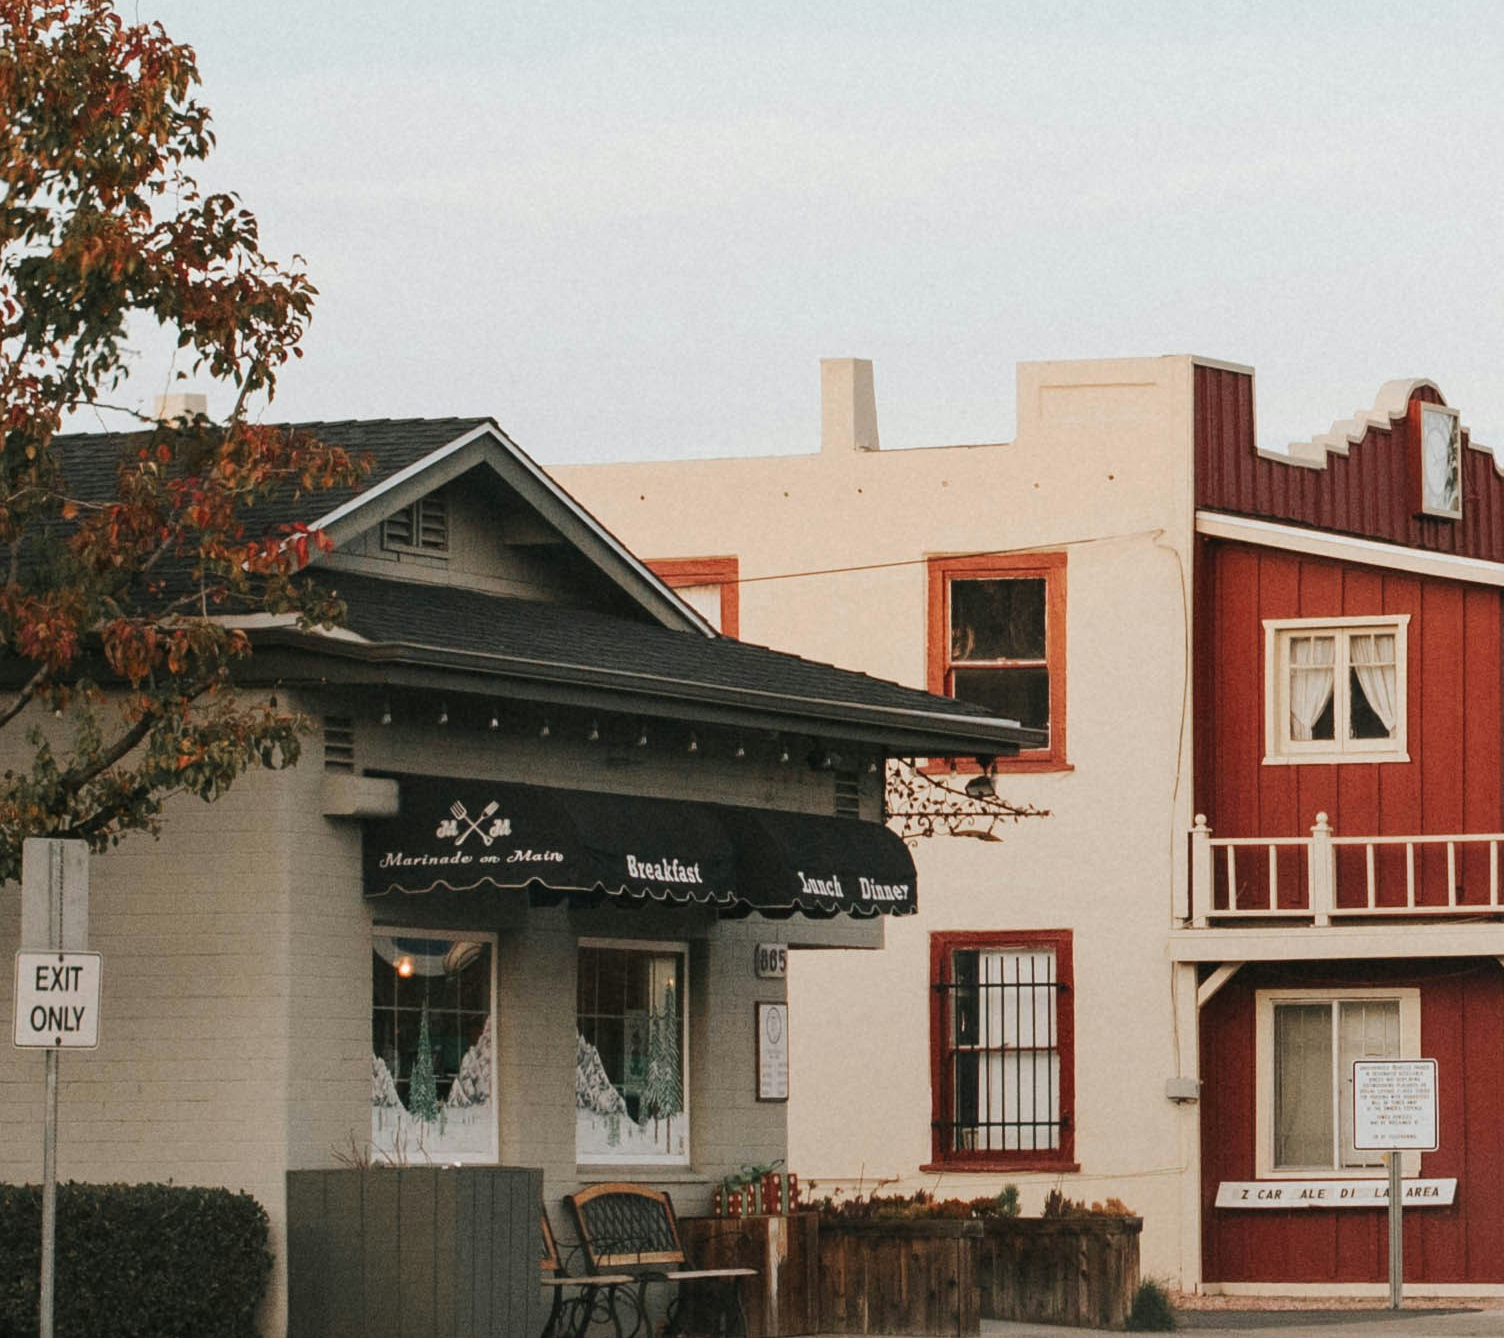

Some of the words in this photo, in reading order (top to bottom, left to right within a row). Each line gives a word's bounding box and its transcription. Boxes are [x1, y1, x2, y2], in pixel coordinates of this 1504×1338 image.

[379, 850, 473, 869] Marinade
[479, 854, 500, 864] on
[506, 849, 564, 863] Main
[626, 854, 703, 884] Breakfast
[797, 871, 844, 898] Lunch
[858, 876, 910, 901] Dinner
[35, 965, 84, 992] EXIT
[30, 1005, 86, 1032] ONLY
[1257, 1188, 1282, 1200] CAR
[1406, 1186, 1438, 1198] AREA
